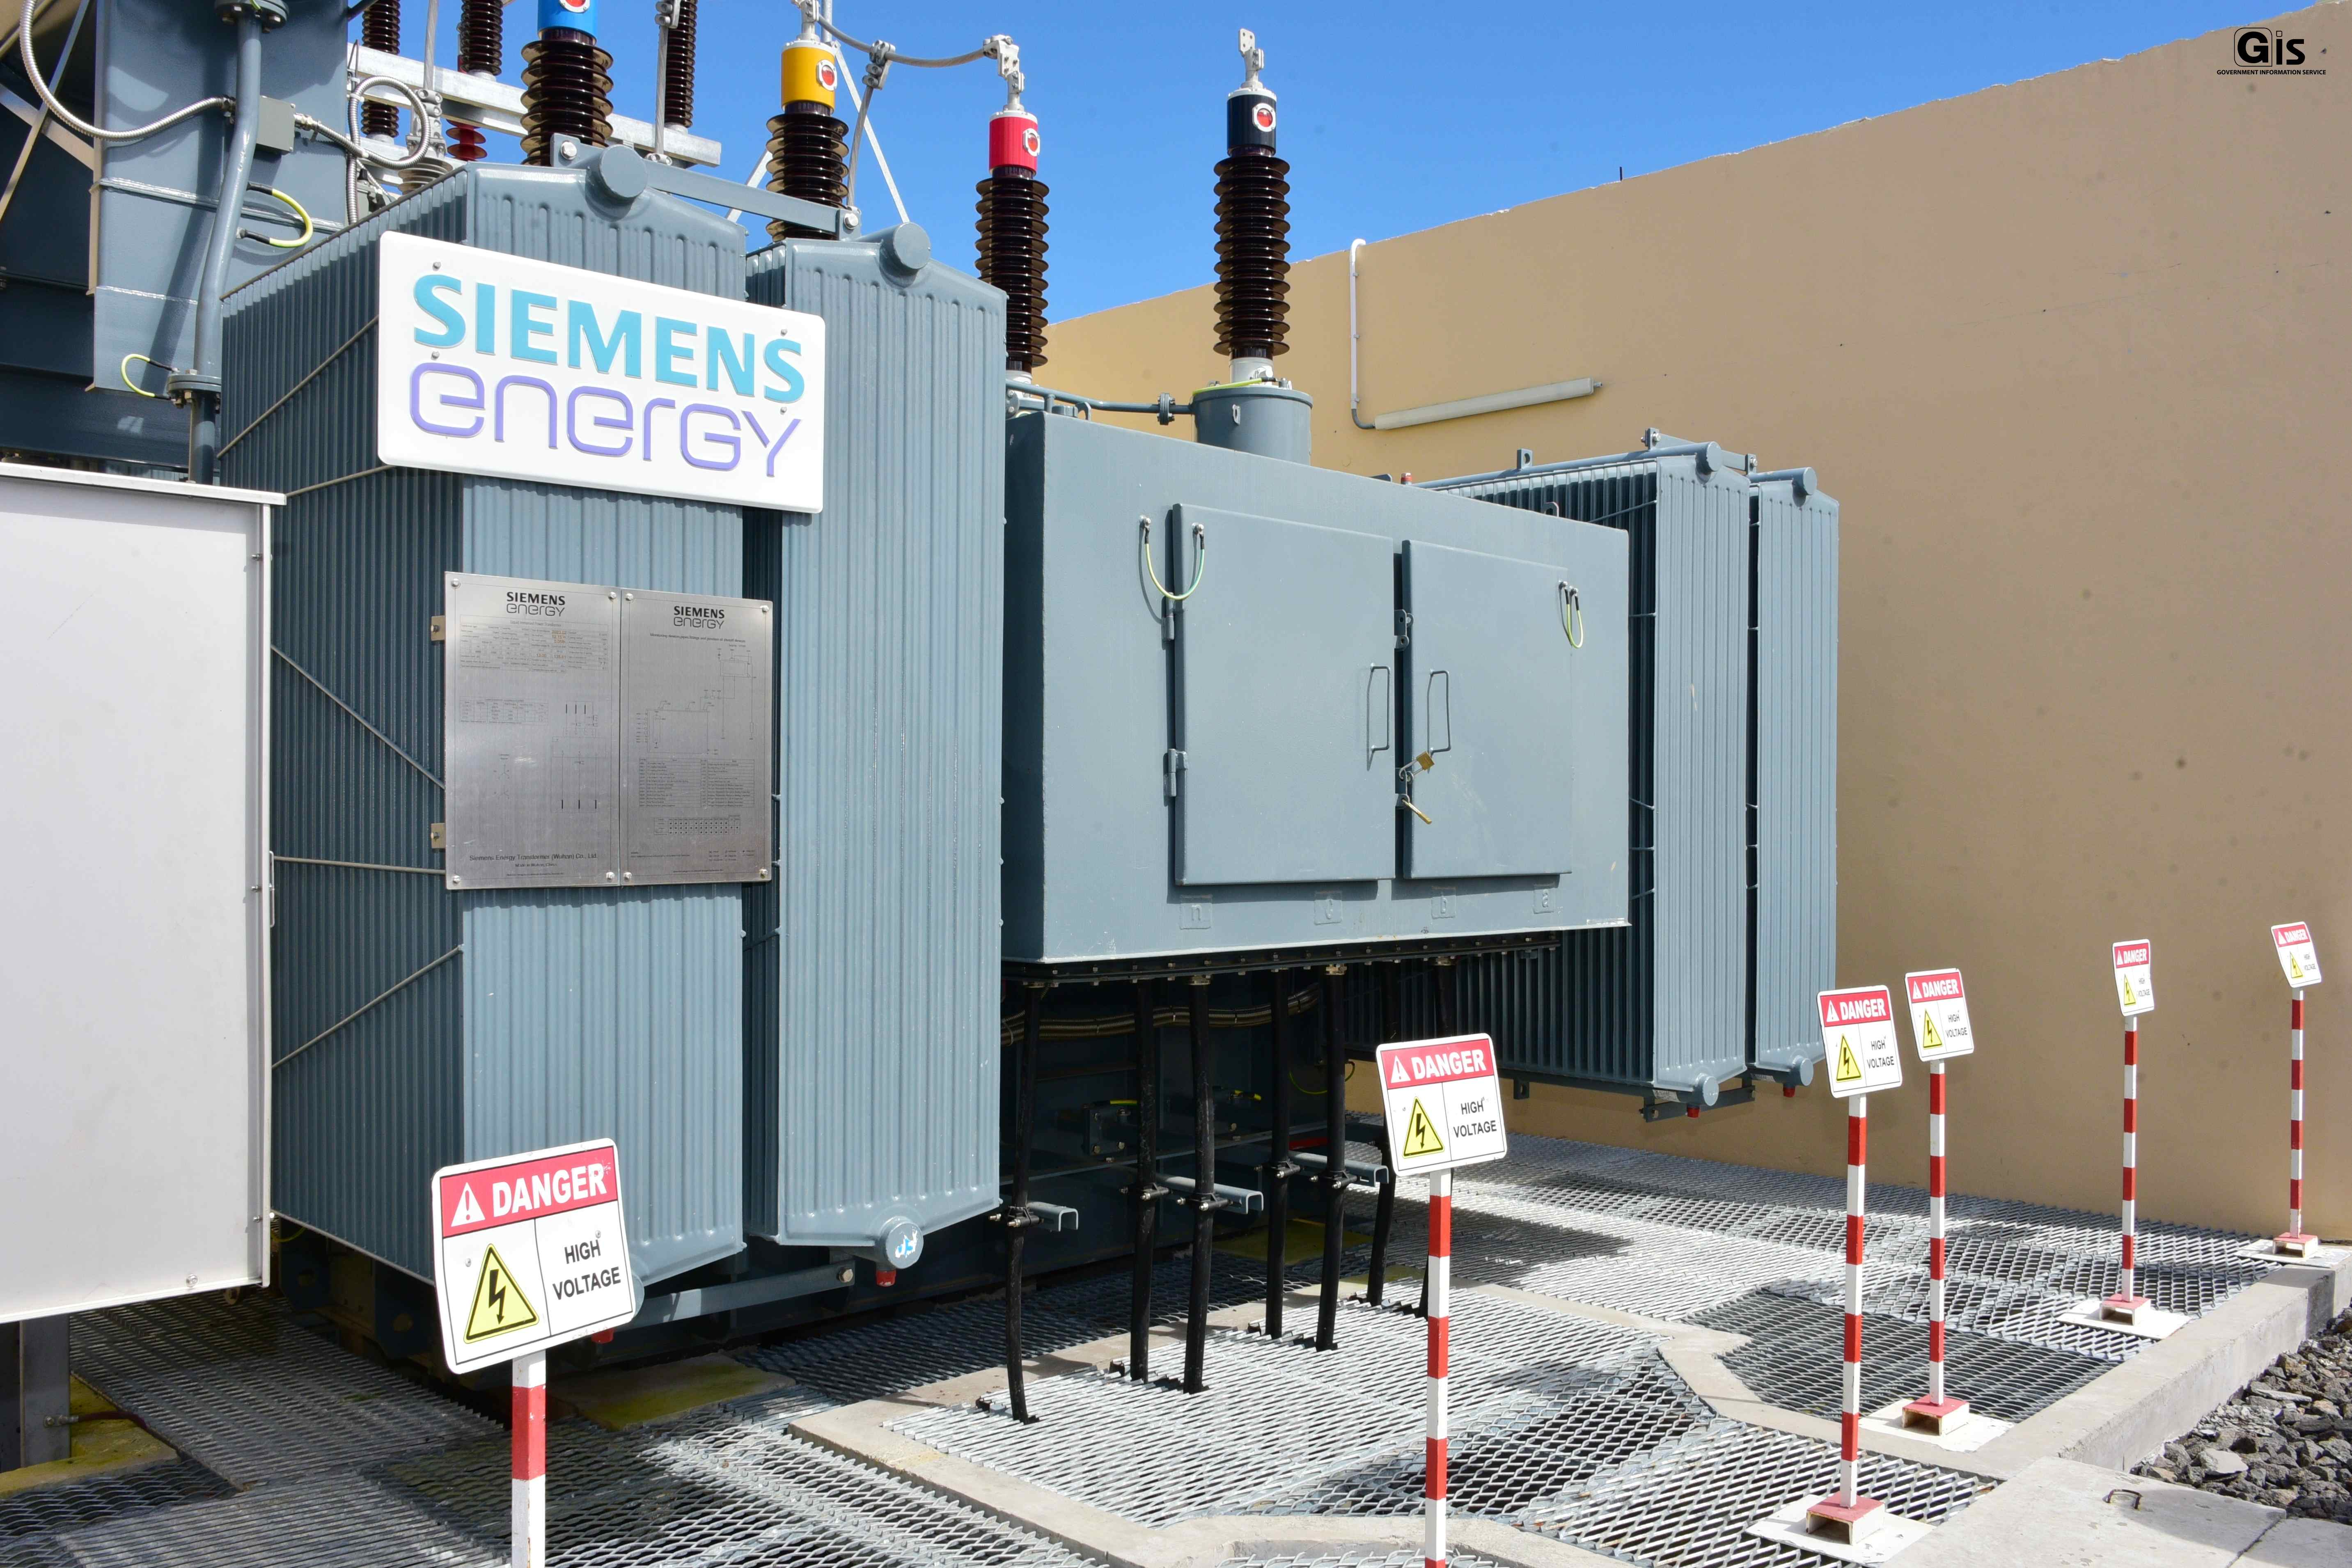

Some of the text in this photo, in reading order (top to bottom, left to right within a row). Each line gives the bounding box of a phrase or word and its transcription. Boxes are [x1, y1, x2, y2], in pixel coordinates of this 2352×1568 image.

[413, 273, 805, 404] SIEMENS
[507, 591, 566, 606] SIEMENS
[674, 606, 725, 619] SIEMENS
[2123, 948, 2147, 964] DANGER
[1922, 979, 1959, 998] DANGER
[1839, 998, 1887, 1020] DANGER
[1948, 1013, 1960, 1022] HIGH
[1945, 1027, 1968, 1038] VOLTAGE
[1871, 1040, 1885, 1051] HIGH
[1411, 1049, 1487, 1080] DANGER
[1866, 1056, 1895, 1069] VOLTAGE
[1460, 1100, 1484, 1115] HIGH
[1453, 1120, 1497, 1138] VOLTAGE
[492, 1162, 607, 1218] DANGER
[564, 1239, 601, 1264] HIGH
[552, 1266, 621, 1300] VOLTAGE
